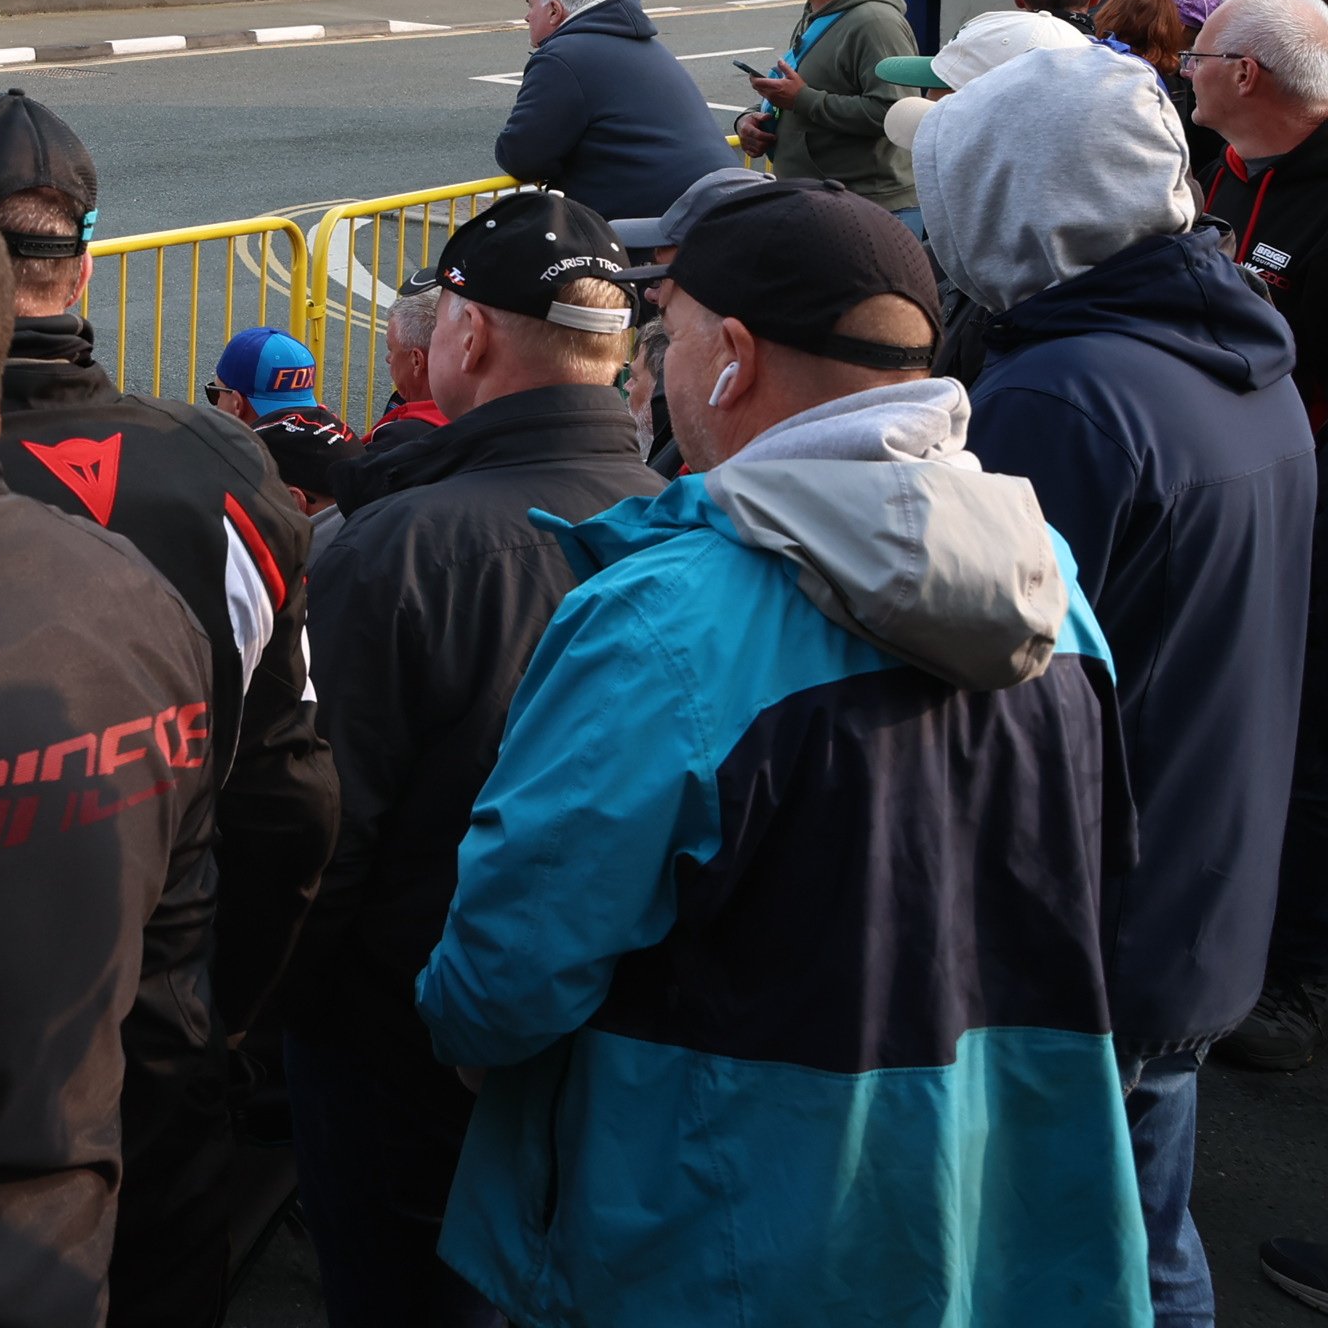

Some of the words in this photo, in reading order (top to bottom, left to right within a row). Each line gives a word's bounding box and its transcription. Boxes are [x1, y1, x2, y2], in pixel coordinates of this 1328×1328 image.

[540, 256, 593, 282] TOURIST
[596, 257, 623, 273] TRO
[273, 366, 315, 390] FOX
